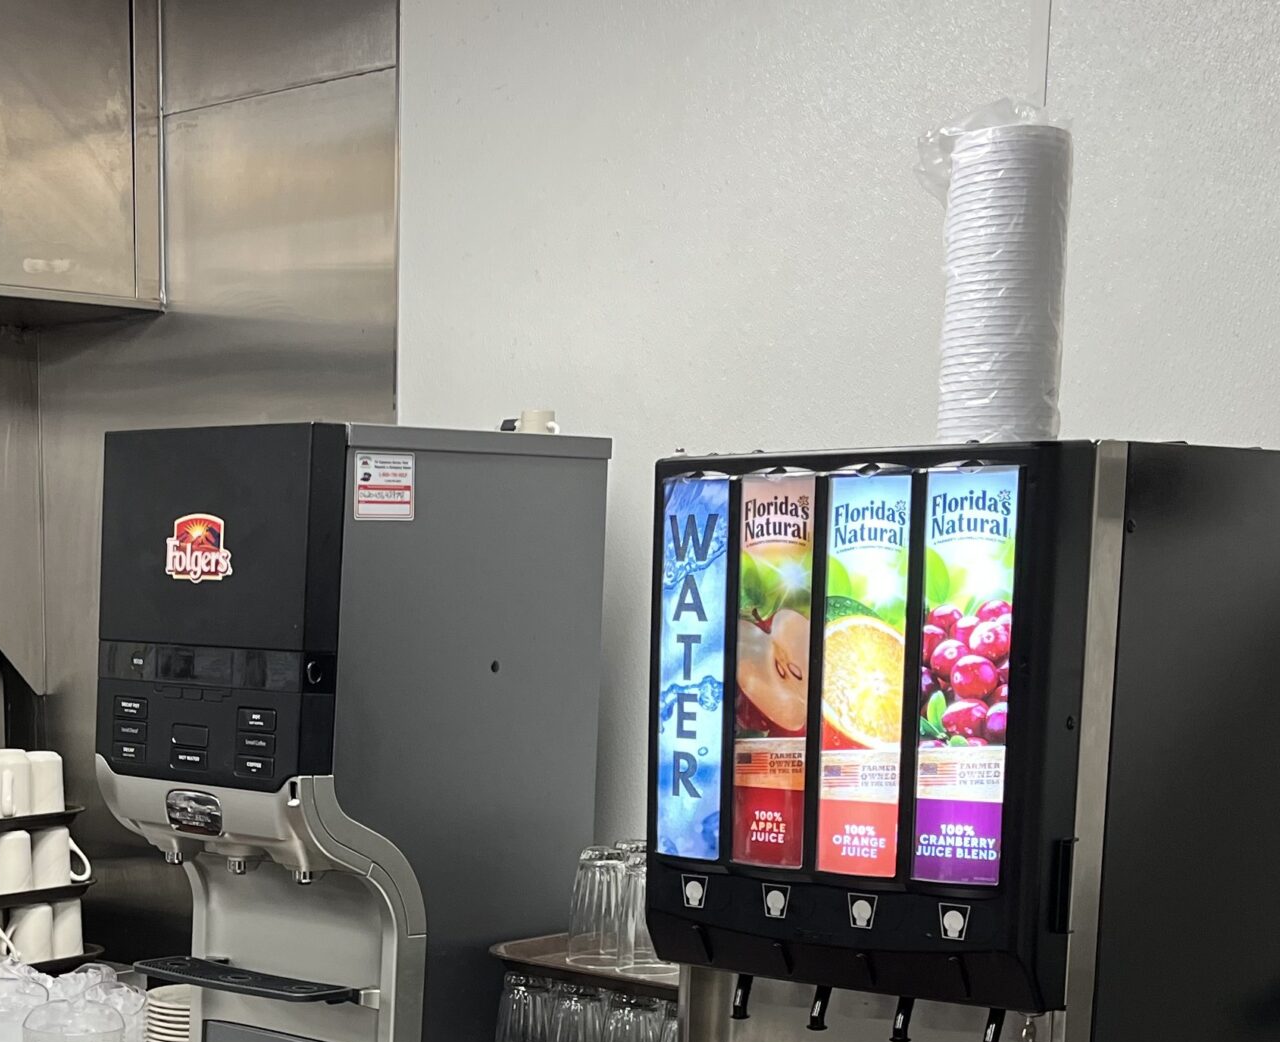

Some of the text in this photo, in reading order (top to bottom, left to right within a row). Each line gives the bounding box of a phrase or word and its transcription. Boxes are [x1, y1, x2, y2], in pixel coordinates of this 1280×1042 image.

[744, 517, 807, 542] Natural
[931, 513, 1008, 540] Natural
[834, 523, 904, 548] Natural
[166, 538, 229, 580] Folgers
[669, 513, 719, 799] WATER
[769, 760, 804, 768] OWNED
[959, 762, 1001, 770] FARMER
[860, 773, 897, 781] OWNED
[958, 770, 1001, 778] OWNED
[754, 810, 783, 822] 100%
[750, 820, 787, 833] APPLE
[844, 824, 876, 837] 100%
[940, 823, 976, 837] 100%
[751, 831, 785, 844] JUICE
[832, 834, 887, 849] ORANGE
[919, 834, 996, 849] CRANBERRY
[841, 846, 878, 859] JUICE
[915, 845, 998, 861] JUICE BLEND
